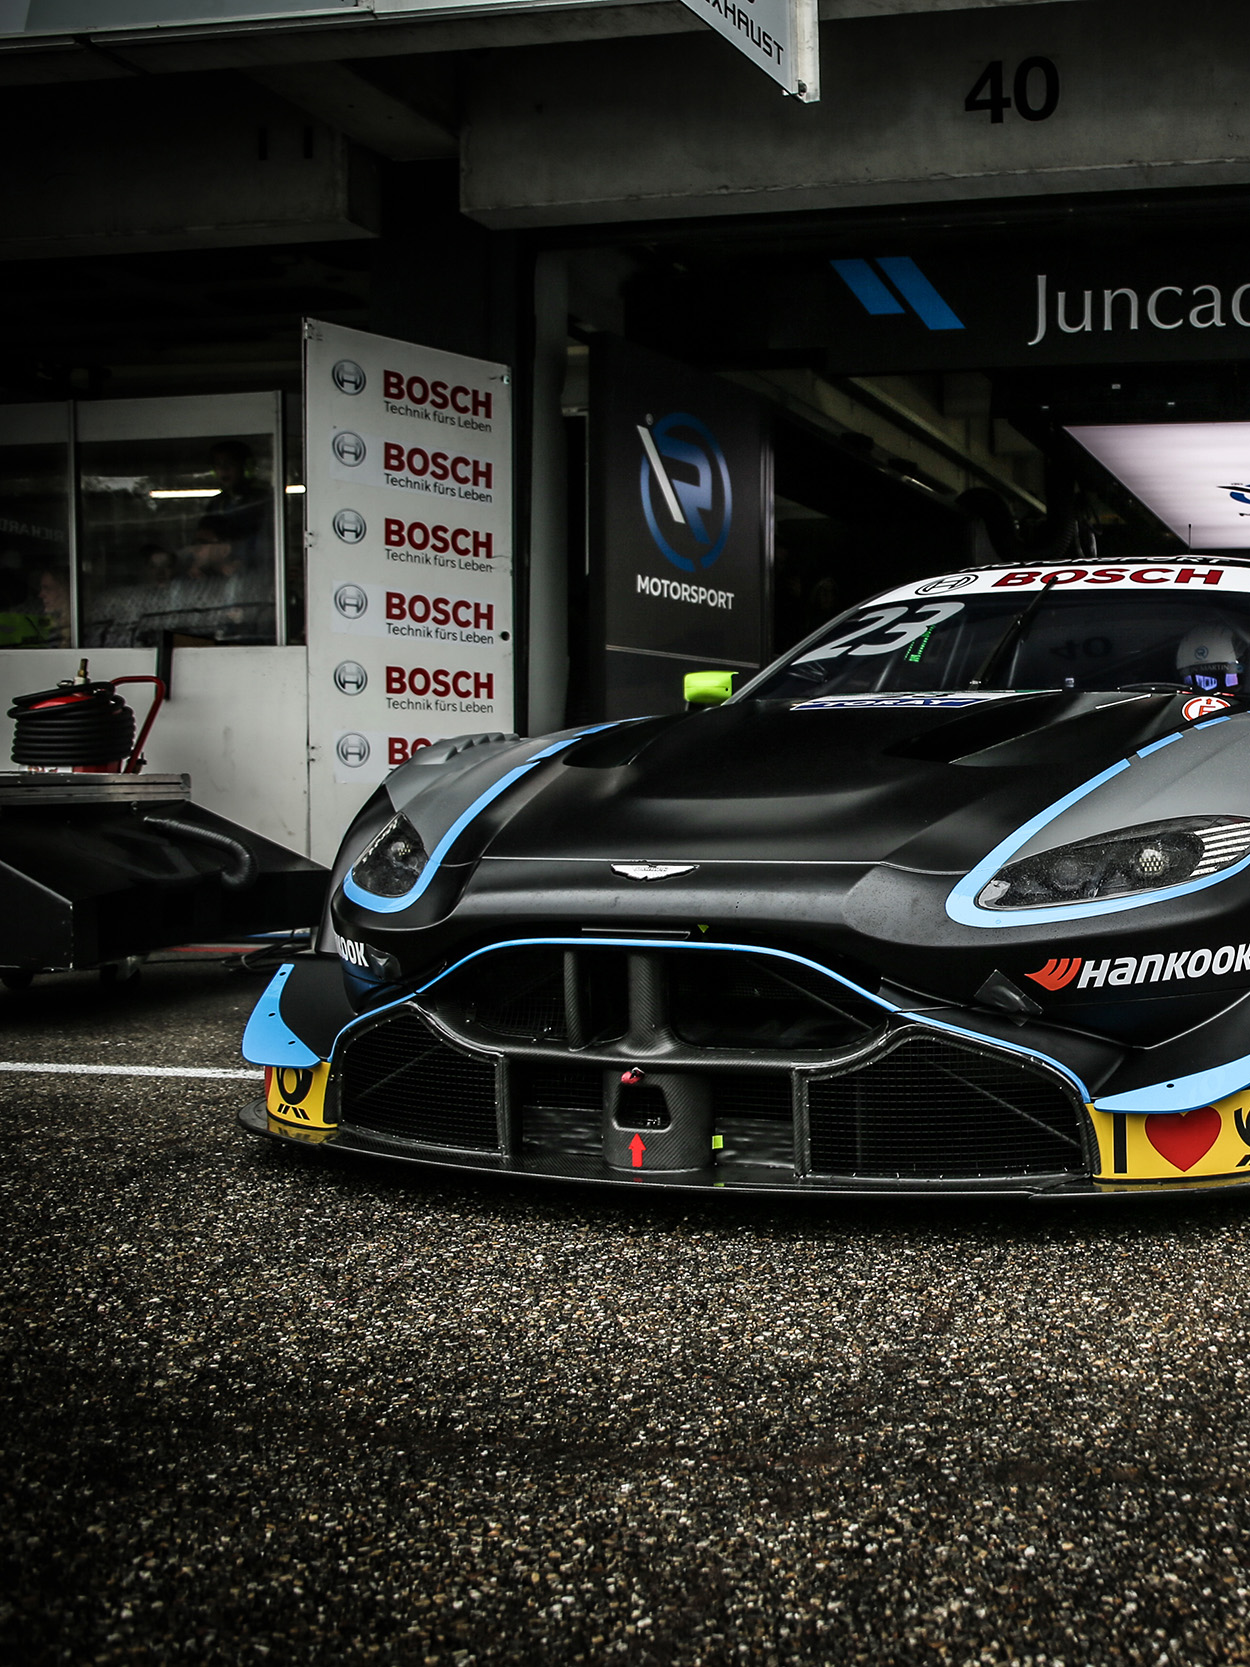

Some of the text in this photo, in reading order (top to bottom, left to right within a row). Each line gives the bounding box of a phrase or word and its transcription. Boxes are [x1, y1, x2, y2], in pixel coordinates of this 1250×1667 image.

[705, 0, 784, 65] XHAUST
[964, 56, 1059, 124] 40
[383, 370, 492, 419] BOSCH
[383, 401, 492, 433] Technik fürs Leben
[384, 442, 493, 489] BOSCH
[384, 473, 493, 503] Technik fürs Leben
[385, 518, 492, 558] BOSCH
[385, 549, 493, 573] Technik fürs Leben
[991, 568, 1224, 587] BOSCH
[636, 574, 735, 610] MOTORSPORT
[386, 591, 494, 630] BOSCH
[386, 623, 494, 644] Technik fürs Leben
[790, 601, 965, 666] 23
[386, 666, 493, 699] BOSCH
[386, 698, 493, 713] Technik fürs Leben
[812, 699, 973, 707] TORAY
